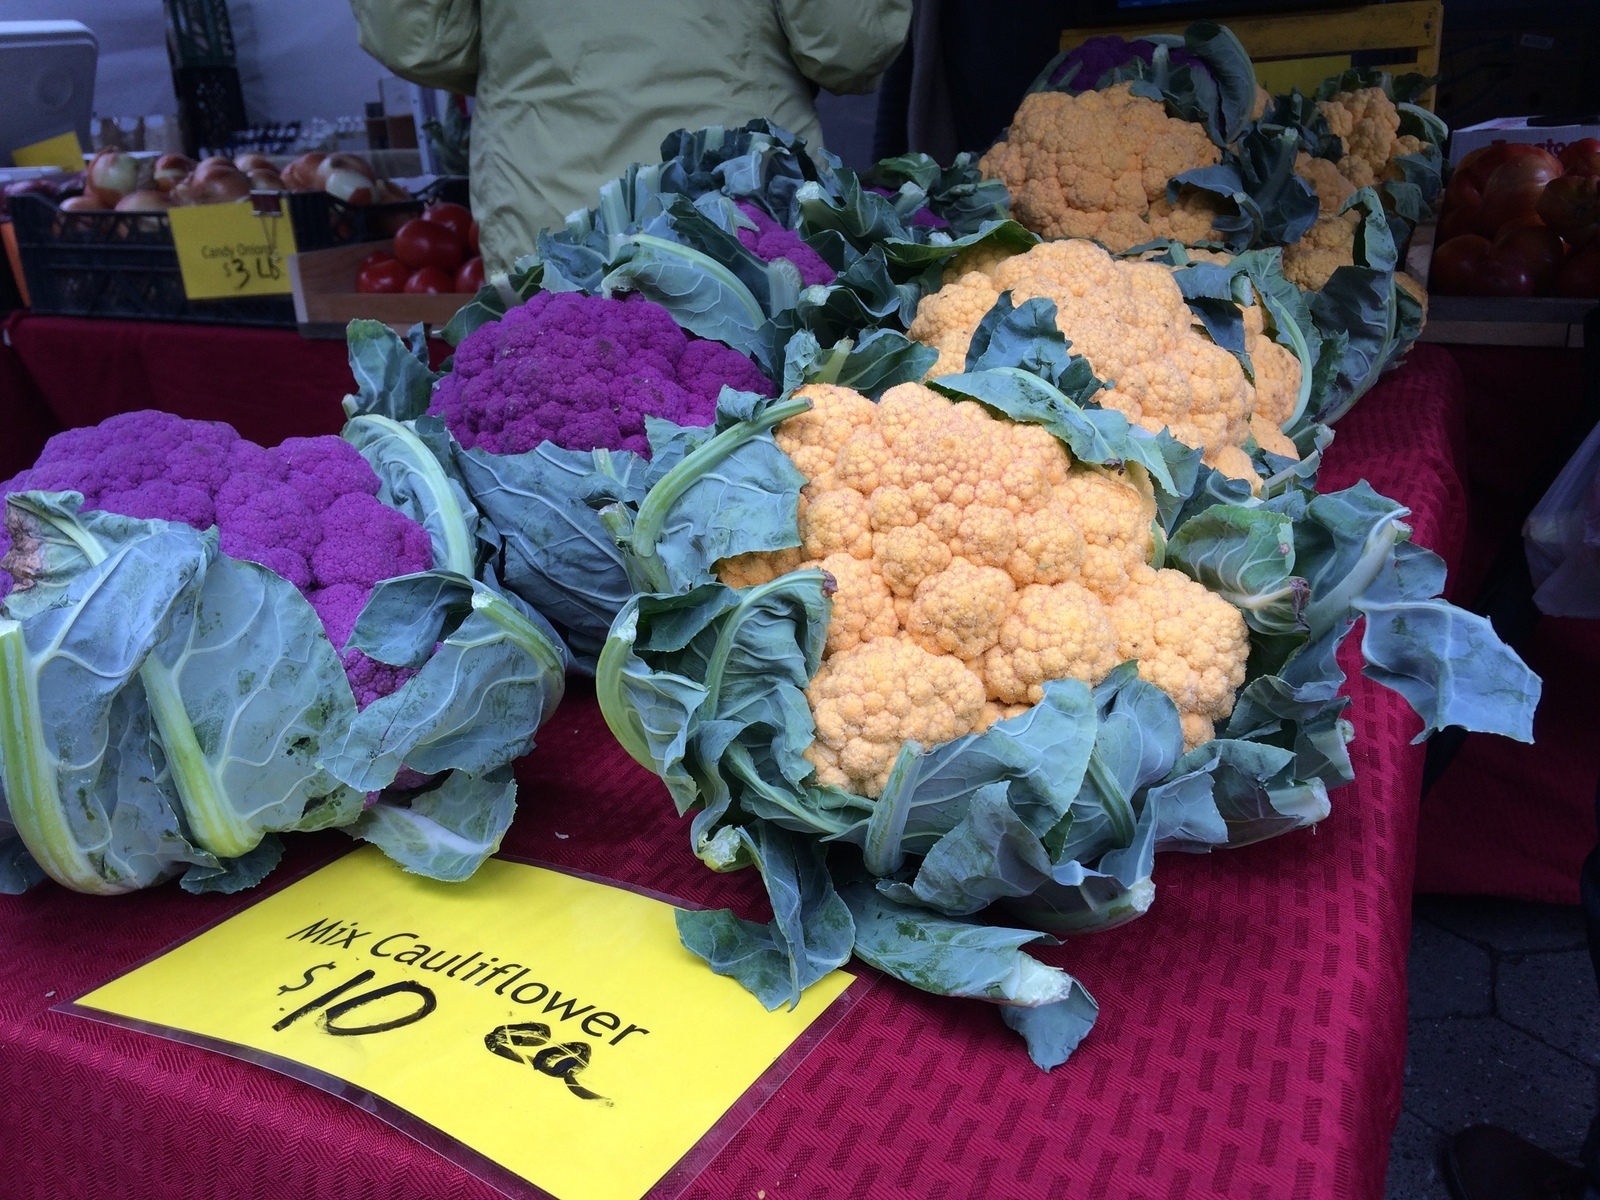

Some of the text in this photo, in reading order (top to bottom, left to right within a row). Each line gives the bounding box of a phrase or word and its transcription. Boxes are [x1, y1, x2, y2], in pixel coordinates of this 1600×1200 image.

[202, 245, 234, 259] Candy
[286, 917, 650, 1046] Mix Cauliflower
